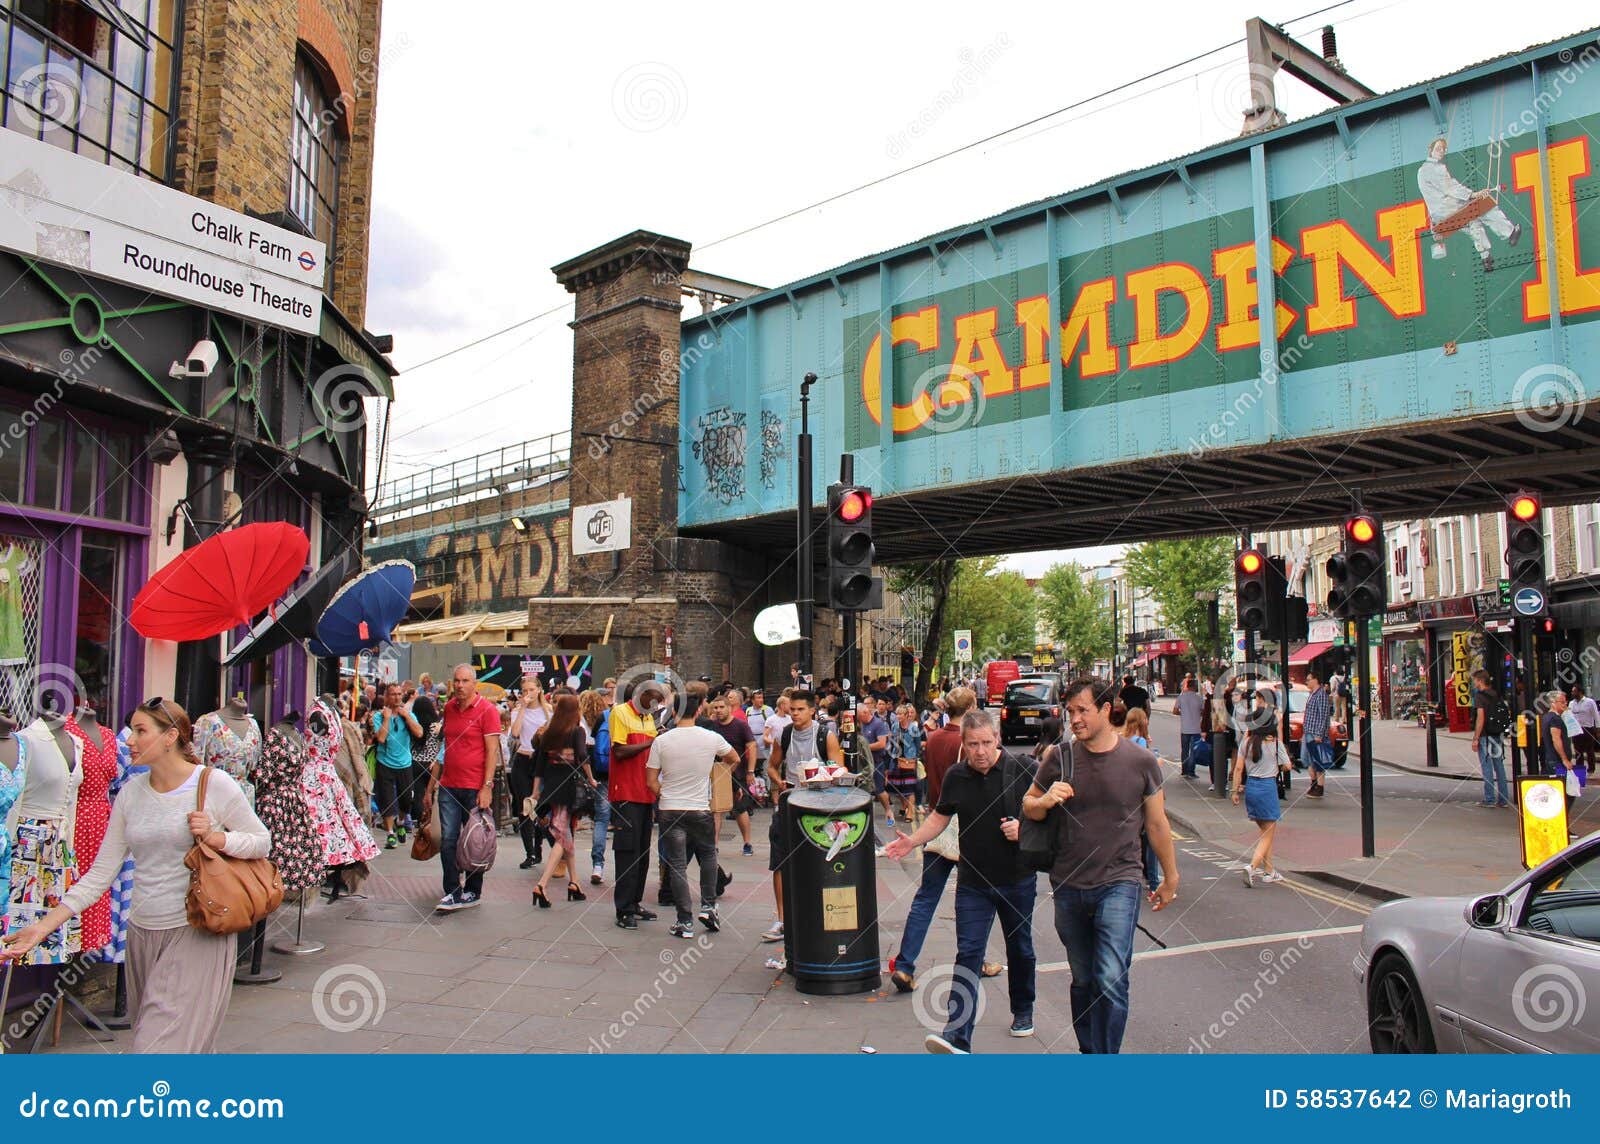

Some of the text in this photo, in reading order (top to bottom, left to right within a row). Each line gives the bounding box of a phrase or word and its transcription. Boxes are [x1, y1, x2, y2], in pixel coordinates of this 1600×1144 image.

[191, 212, 292, 263] Chalk Farm
[123, 243, 313, 319] Roundhouse Theatre
[862, 201, 1432, 434] CAMDEN
[1454, 634, 1470, 706] TATTOO
